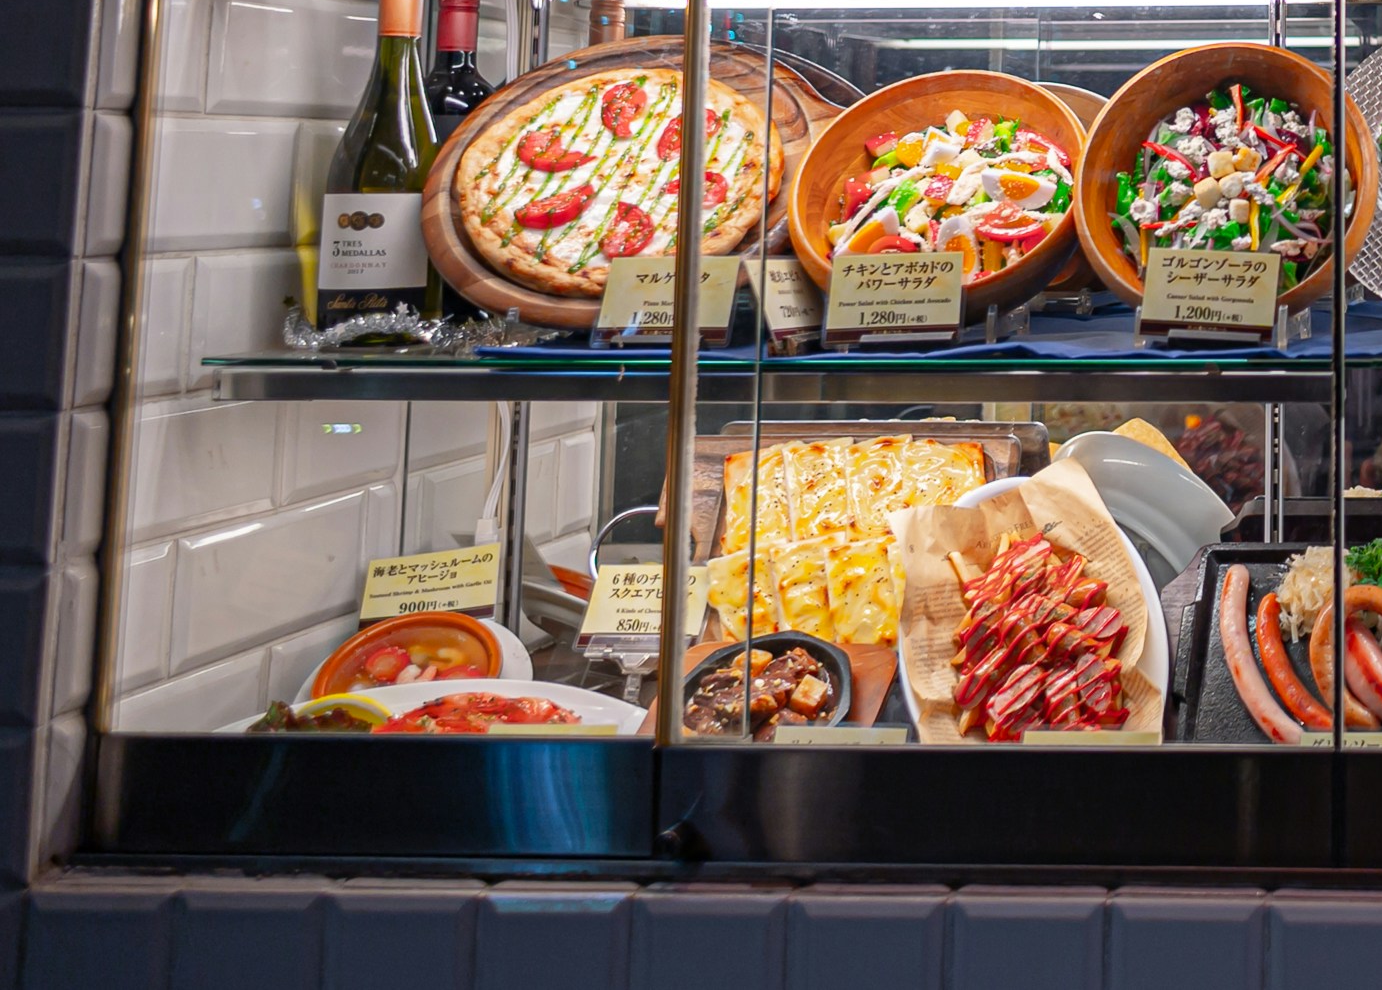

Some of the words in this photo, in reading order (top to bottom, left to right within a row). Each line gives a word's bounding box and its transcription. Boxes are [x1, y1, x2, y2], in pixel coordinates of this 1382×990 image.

[341, 249, 387, 257] MEDALLAS
[842, 260, 954, 278] チキンとアボカドの
[1161, 255, 1267, 274] ゴルゴンゾーラの
[857, 275, 938, 291] パワーサラダ
[1167, 270, 1261, 289] シーザーサラダ
[858, 310, 928, 327] 1,280円(+税)
[1174, 304, 1243, 323] 1,200円(+税)
[372, 553, 494, 578] 海老とマッシュルームの
[407, 570, 458, 585] アヒージョ
